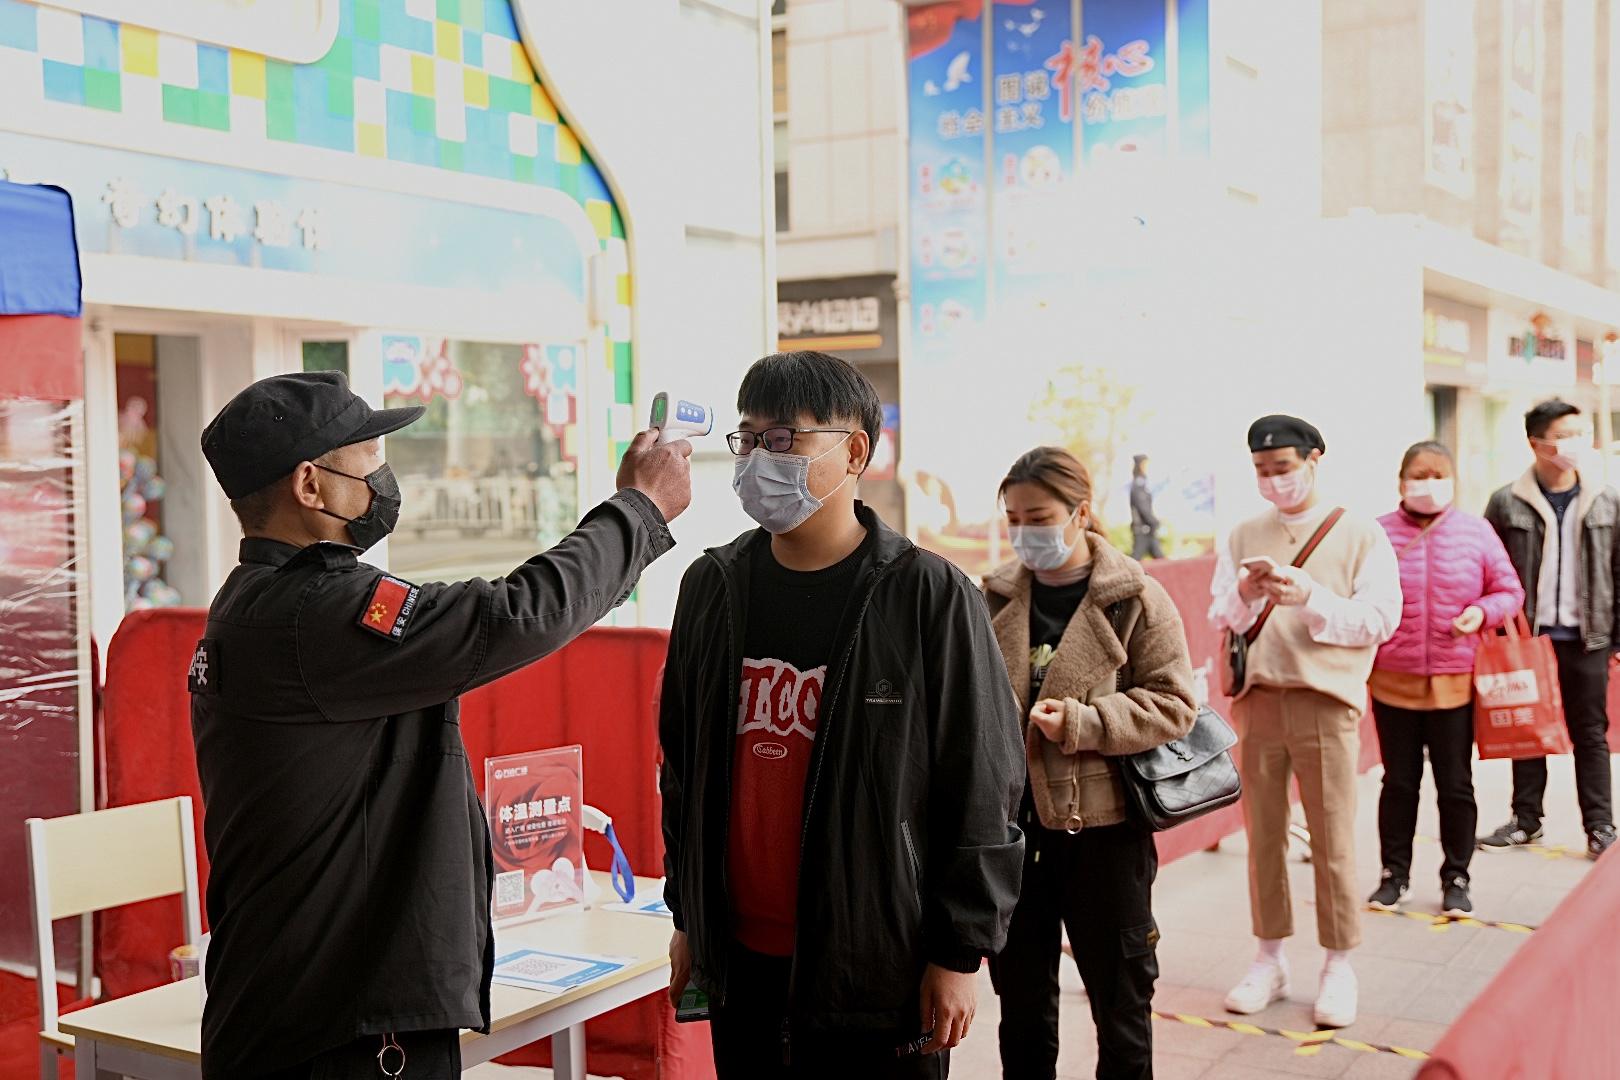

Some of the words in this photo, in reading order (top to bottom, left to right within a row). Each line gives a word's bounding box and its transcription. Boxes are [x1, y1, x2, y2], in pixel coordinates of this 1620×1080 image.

[1046, 36, 1151, 121] 核心
[392, 616, 407, 636] 保安
[500, 796, 571, 823] 体温测量点
